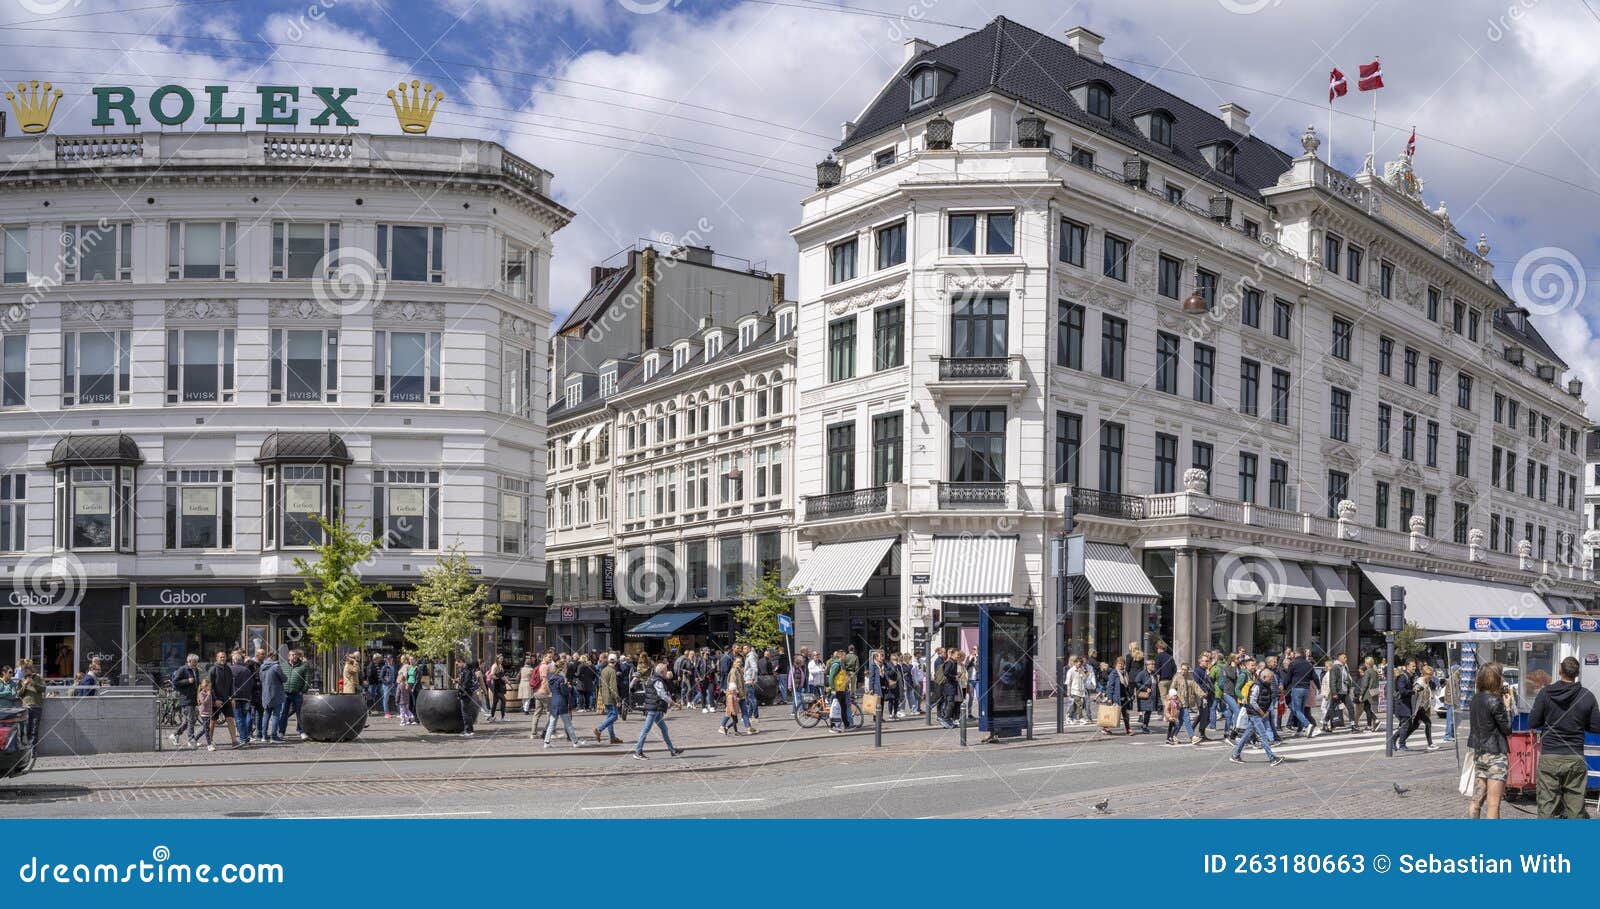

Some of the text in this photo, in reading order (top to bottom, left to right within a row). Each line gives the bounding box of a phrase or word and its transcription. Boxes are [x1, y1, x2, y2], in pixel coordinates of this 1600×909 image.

[92, 84, 359, 126] ROLEX
[289, 391, 320, 400] HVISK
[392, 393, 421, 401] HVISK
[9, 591, 56, 606] Gabor
[160, 589, 207, 604] Gabor
